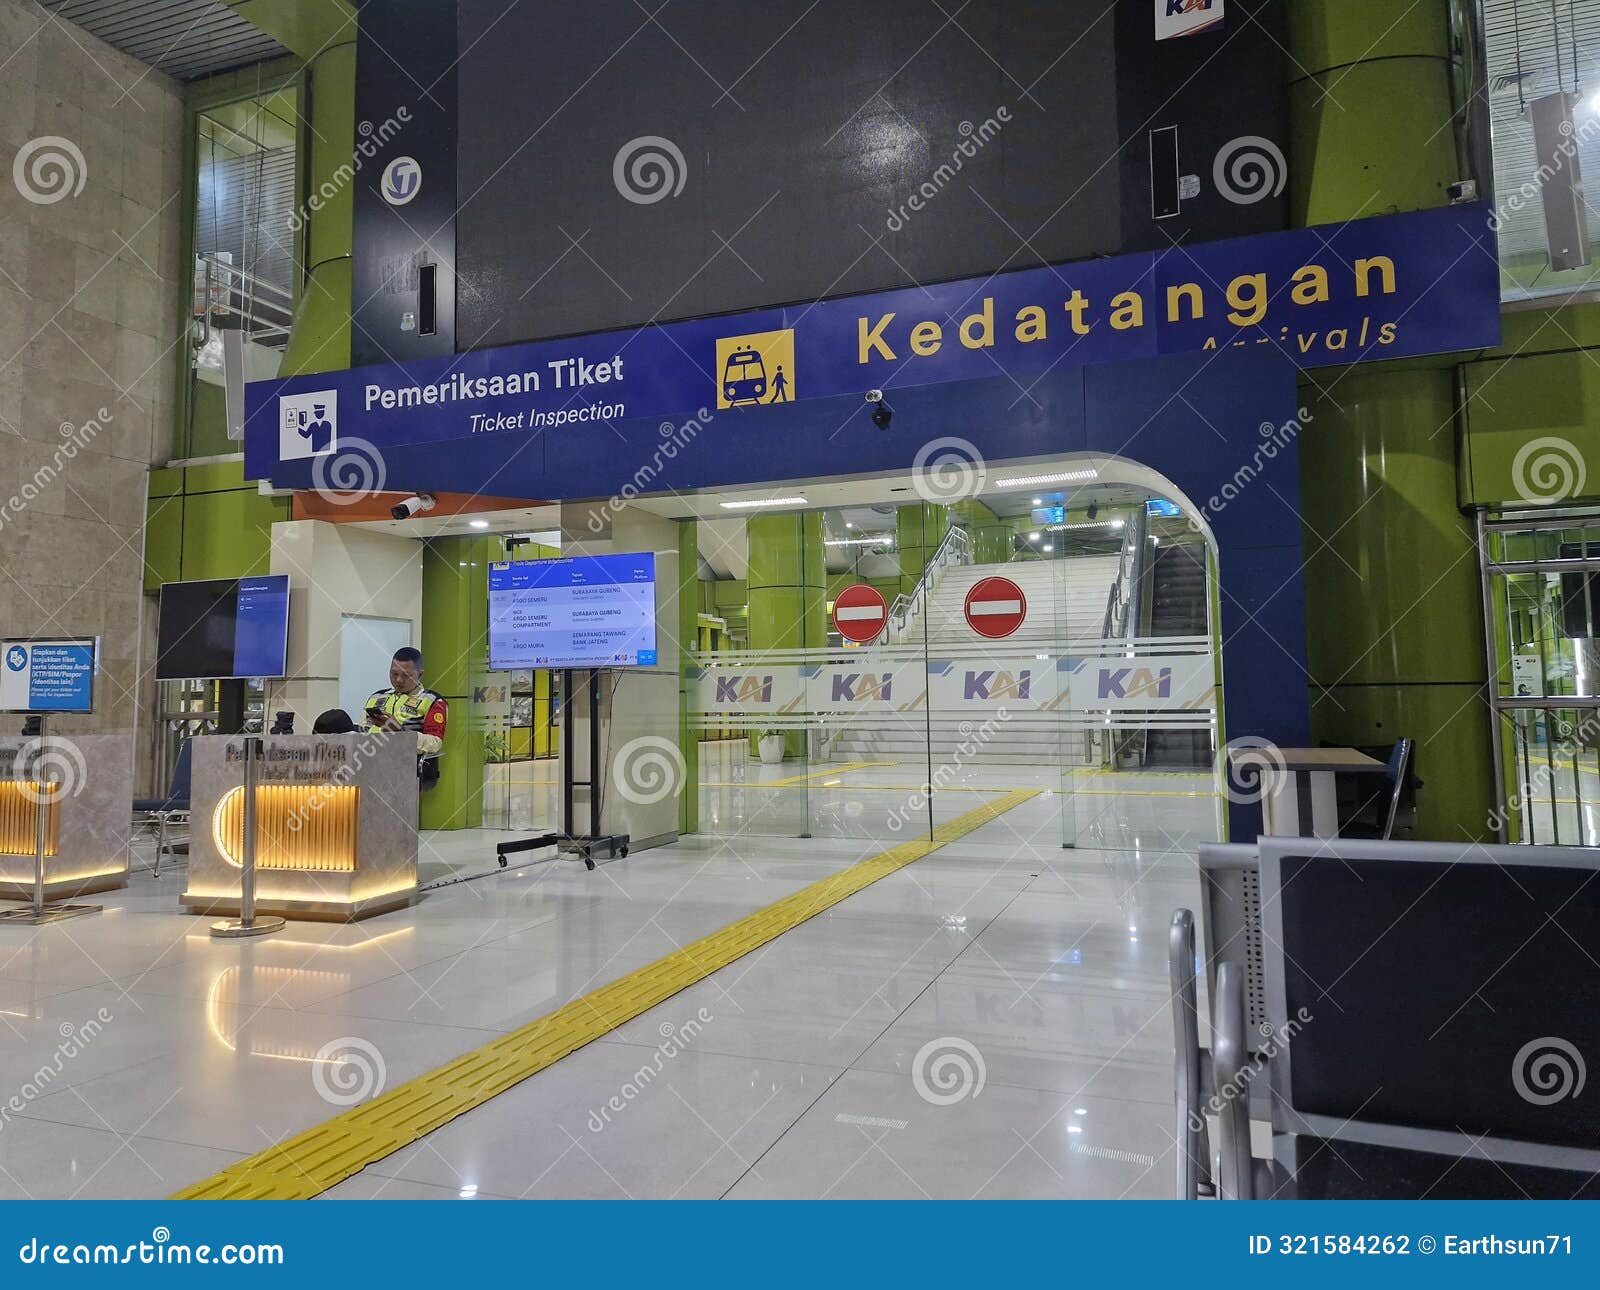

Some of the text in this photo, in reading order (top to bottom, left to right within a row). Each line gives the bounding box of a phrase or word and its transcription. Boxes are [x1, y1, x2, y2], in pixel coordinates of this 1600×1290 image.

[856, 255, 1397, 364] Kedatangan
[1202, 317, 1397, 353] Avals
[365, 355, 624, 411] Pemeriksaan Tiket
[470, 404, 625, 433] Ticket Inspection
[473, 686, 506, 703] KAI
[716, 675, 773, 703] KAI
[832, 672, 892, 702] KAI
[963, 669, 1031, 700] KAI
[1098, 667, 1171, 699] KAI
